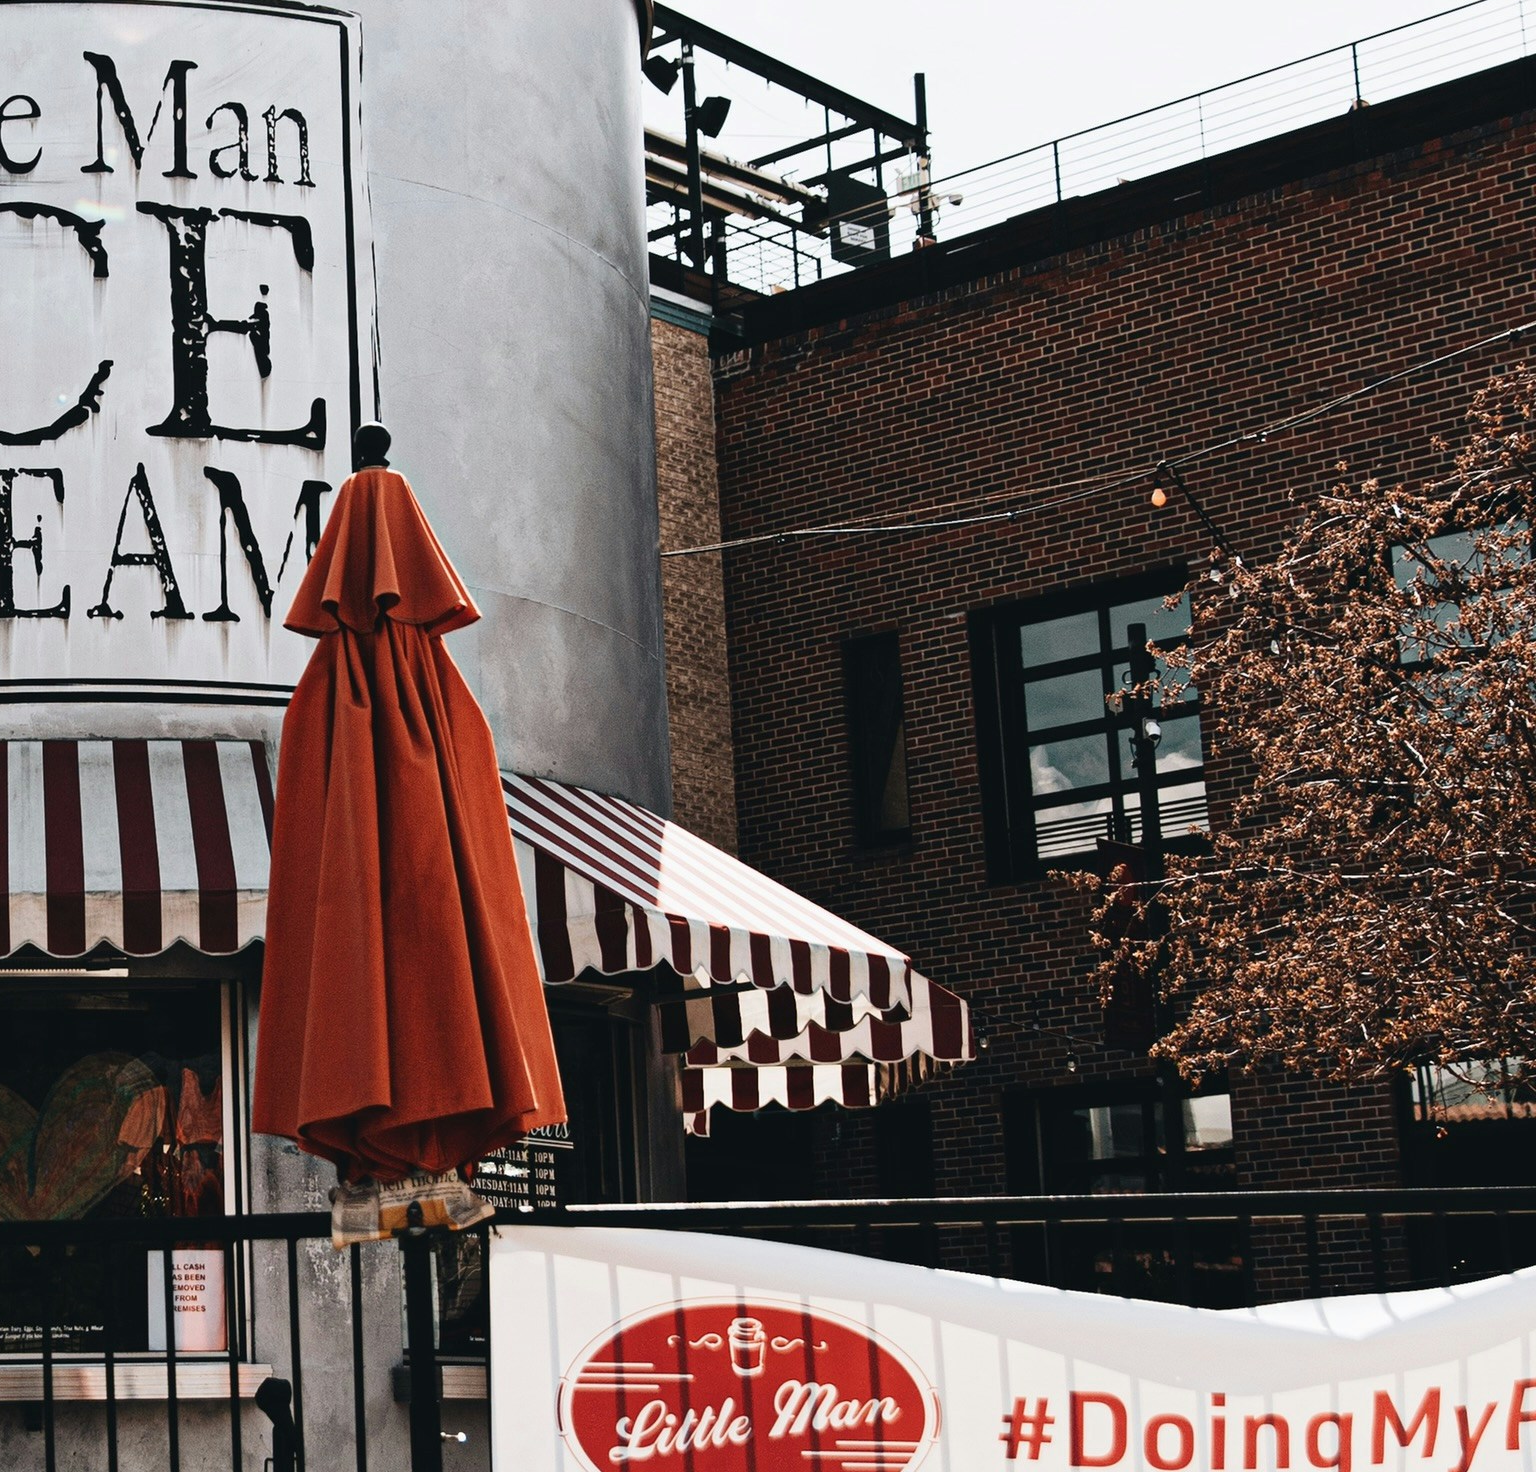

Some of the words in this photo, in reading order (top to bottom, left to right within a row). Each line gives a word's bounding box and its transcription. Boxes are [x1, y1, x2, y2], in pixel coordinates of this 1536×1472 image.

[81, 50, 316, 188] Man
[533, 1151, 555, 1165] 10PM
[534, 1168, 556, 1181] 10PM
[535, 1183, 556, 1197] 10PM
[608, 1396, 752, 1465] Little
[767, 1379, 902, 1440] Man
